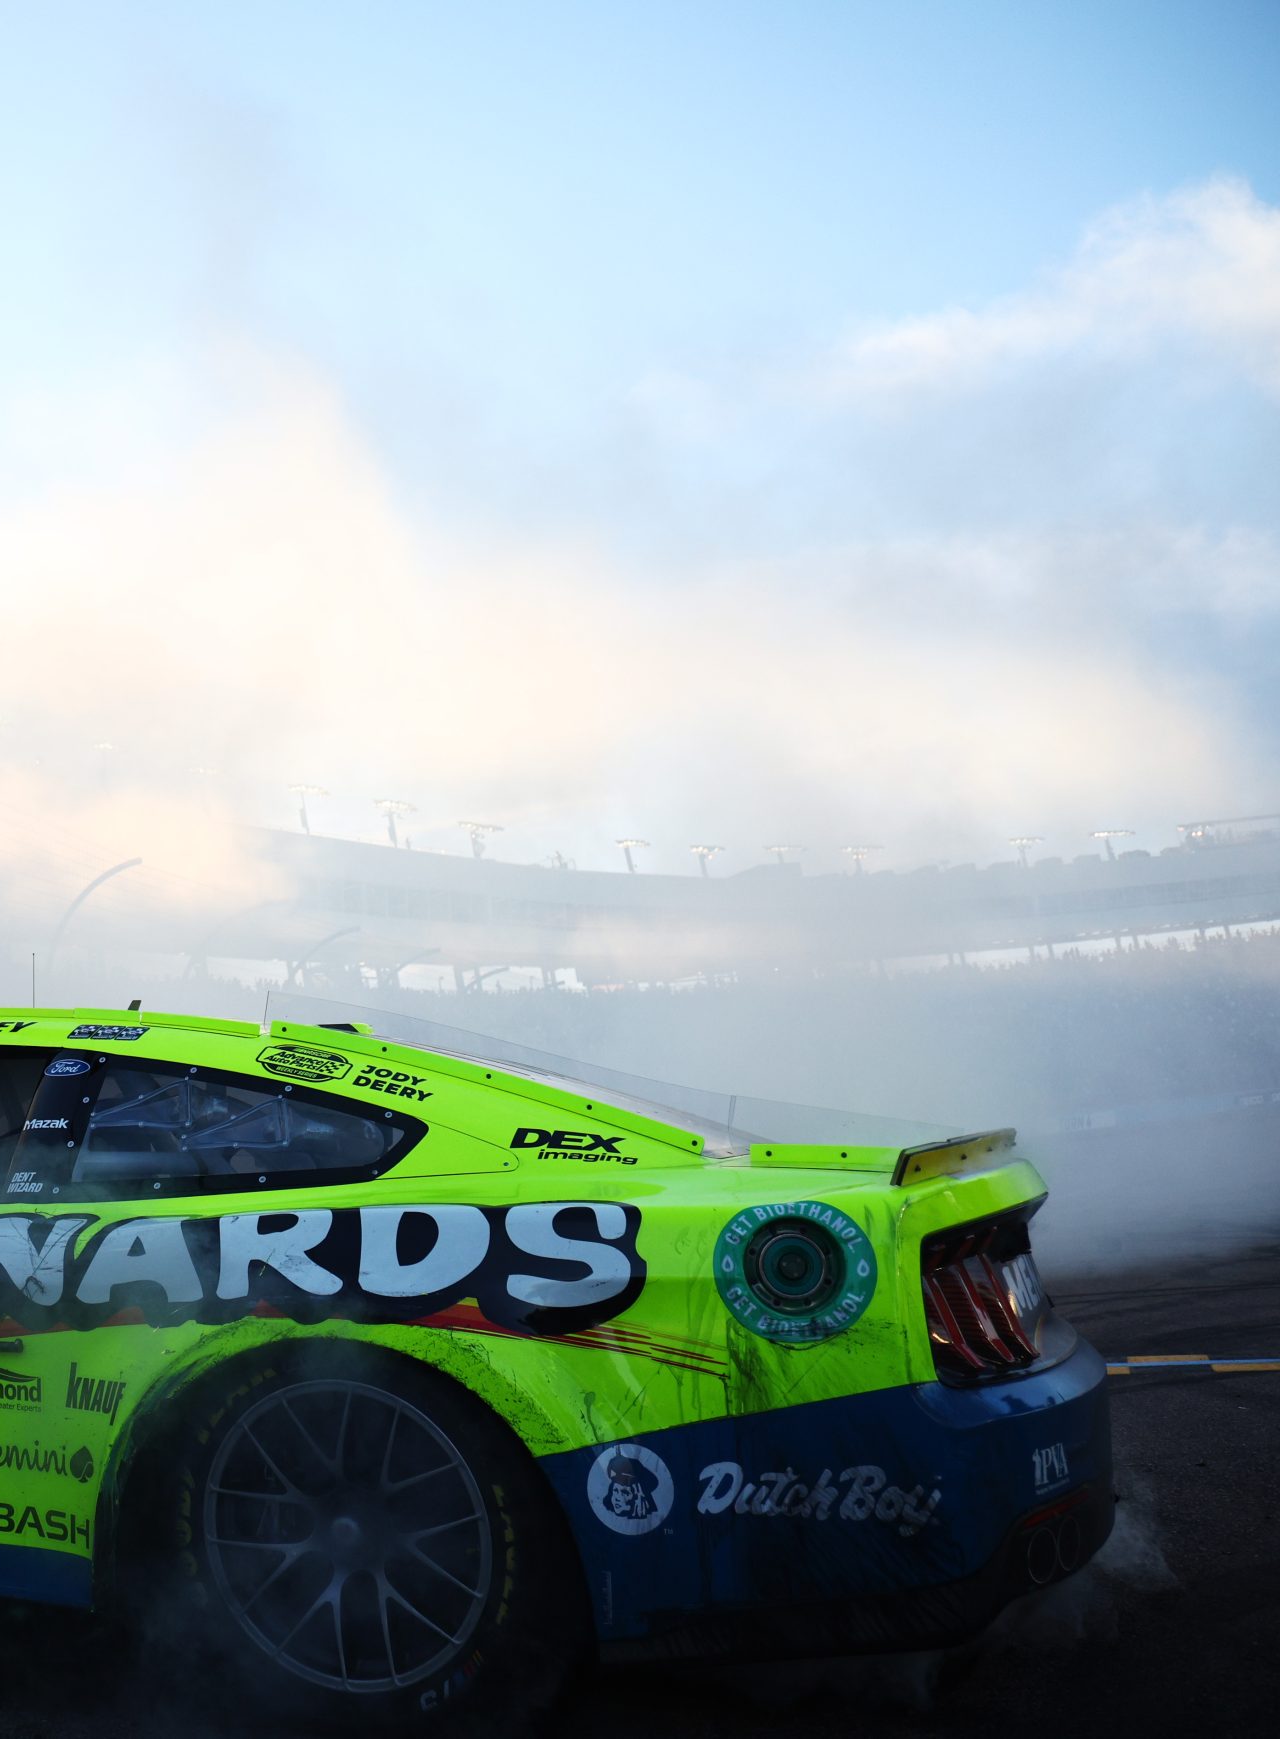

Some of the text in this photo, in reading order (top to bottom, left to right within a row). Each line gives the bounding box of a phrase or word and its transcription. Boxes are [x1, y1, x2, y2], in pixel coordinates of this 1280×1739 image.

[50, 1061, 81, 1074] Ford
[265, 1055, 320, 1073] Auto Parts
[276, 1050, 326, 1067] Advance
[360, 1064, 427, 1086] JODY
[352, 1075, 433, 1102] DEERY
[23, 1118, 70, 1131] Mazak
[509, 1126, 627, 1154] DEX
[536, 1148, 638, 1166] imaging
[12, 1171, 37, 1183] DENT
[6, 1182, 43, 1194] WIZARD
[725, 1201, 864, 1254] GET BIOETHANOL
[726, 1286, 758, 1317] GET
[65, 1361, 127, 1426] KNAUF
[16, 1403, 42, 1413] Experts
[696, 1460, 945, 1538] Dutch Boy
